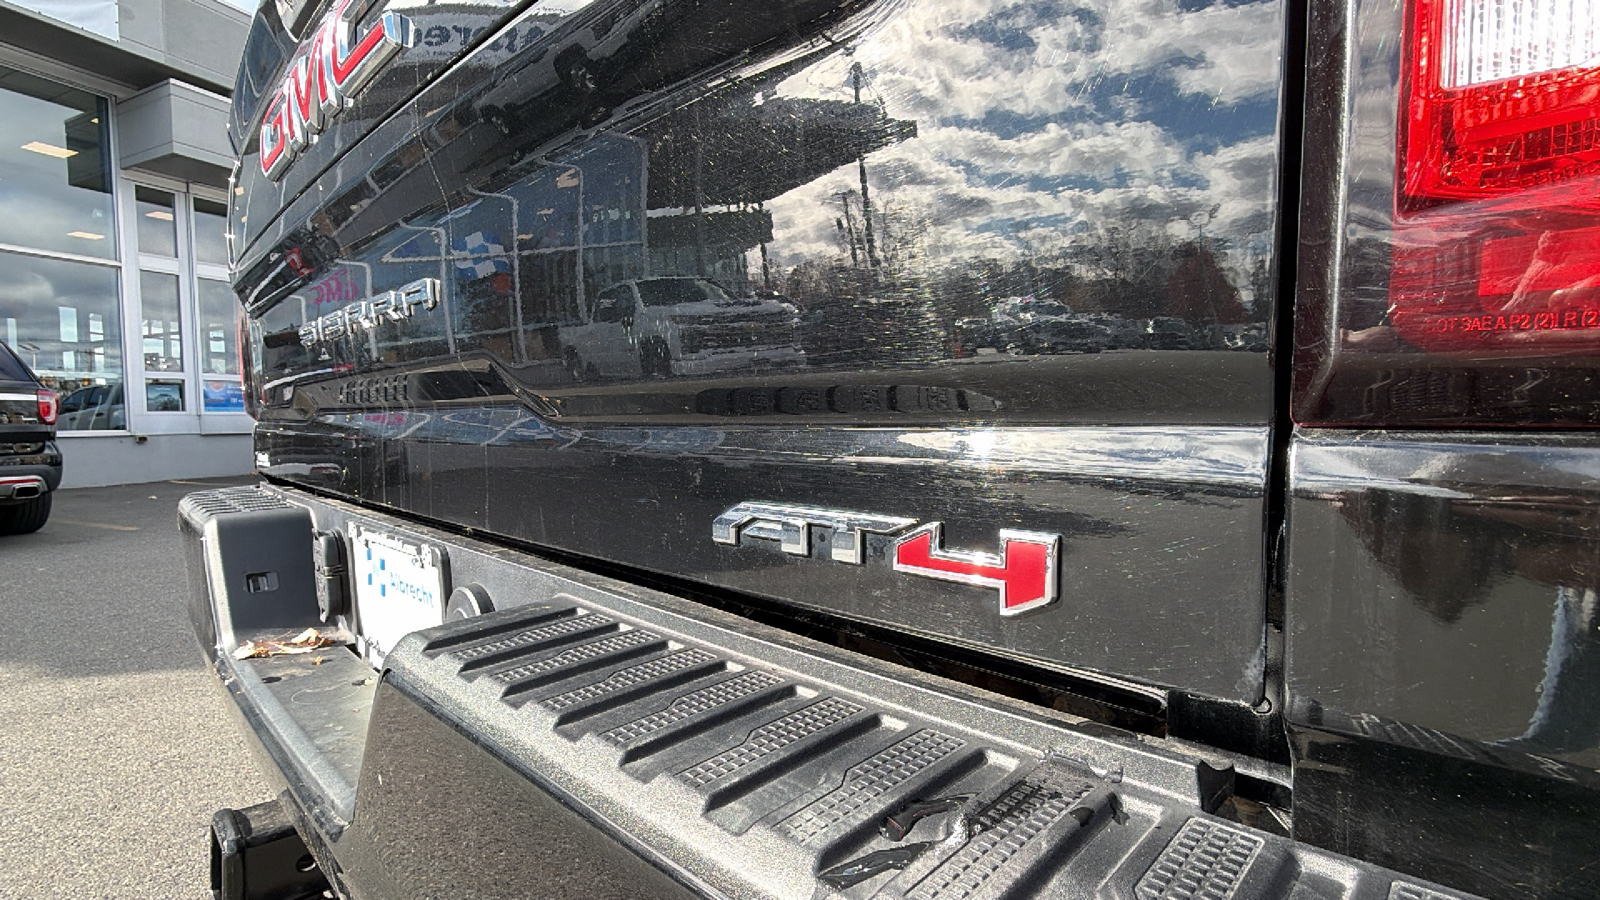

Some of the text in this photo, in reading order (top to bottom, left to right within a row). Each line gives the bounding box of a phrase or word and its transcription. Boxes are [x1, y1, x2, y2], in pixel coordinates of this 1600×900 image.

[260, 0, 416, 182] GMC
[298, 277, 441, 348] SIERRA
[1460, 315, 1492, 332] SAE
[1494, 315, 1507, 331] A
[1581, 310, 1600, 327] (2
[712, 501, 1061, 616] AT4
